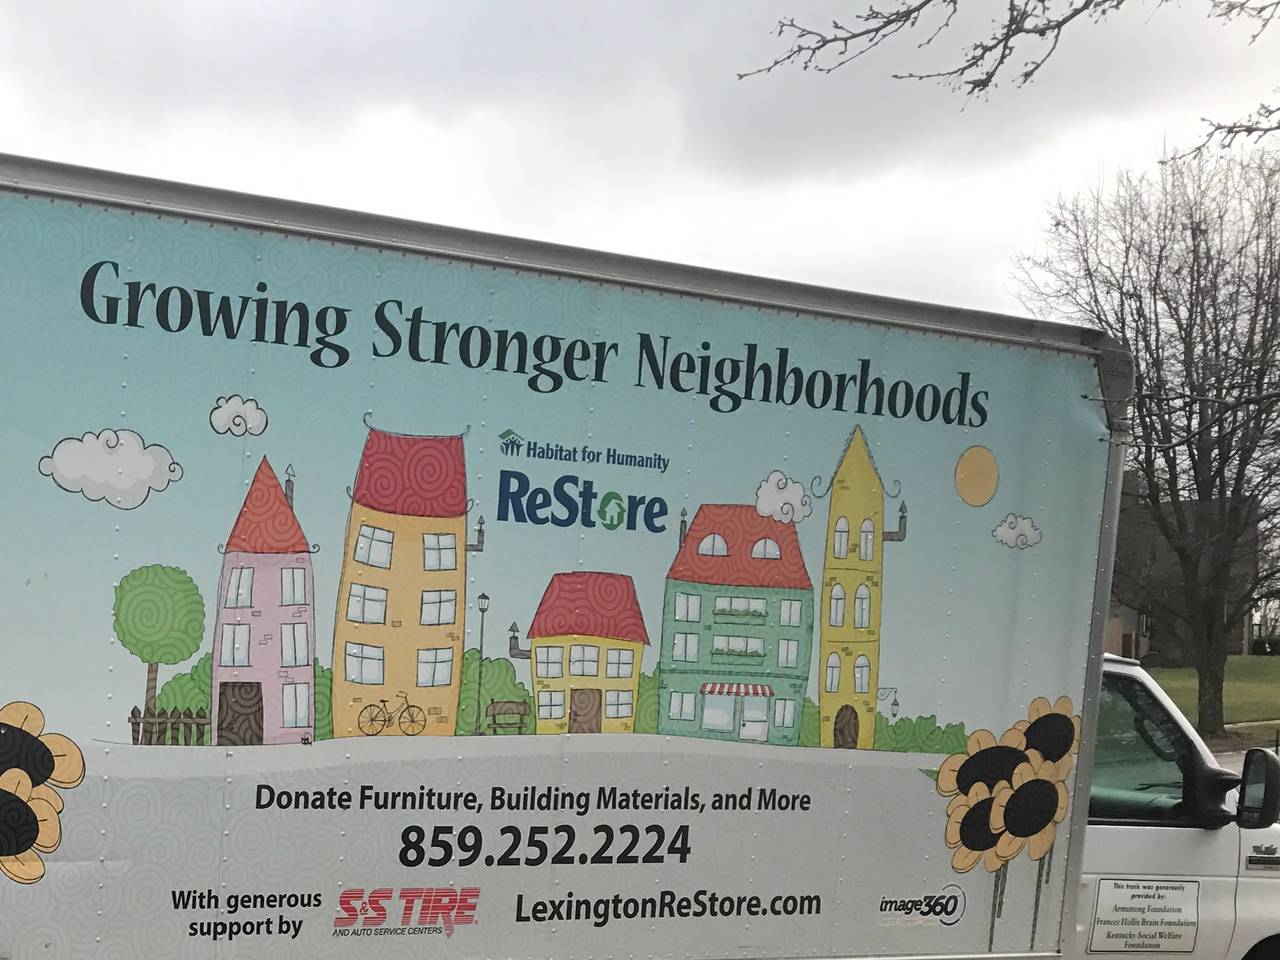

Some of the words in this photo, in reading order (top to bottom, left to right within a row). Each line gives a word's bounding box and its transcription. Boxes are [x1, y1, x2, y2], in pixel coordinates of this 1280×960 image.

[79, 259, 352, 368] Growing
[372, 299, 619, 393] Stronger
[634, 331, 989, 428] Neighborhoods
[526, 441, 578, 463] Habitat
[581, 445, 602, 463] for
[606, 448, 670, 474] Humanity
[497, 469, 668, 533] ReStore
[255, 784, 352, 810] Donate
[359, 785, 483, 814] Furniture,
[490, 786, 590, 816] Building
[596, 786, 706, 814] Materials,
[711, 787, 753, 811] and
[756, 788, 811, 811] More
[399, 824, 691, 867] 859.252.2224
[171, 889, 219, 910] With
[226, 890, 322, 914] generous
[399, 887, 481, 934] TIRE
[515, 890, 821, 927] LexingtonReStore.com
[880, 895, 959, 916] image360
[1112, 904, 1146, 914] Armstrong
[1147, 905, 1182, 913] Foundation
[188, 917, 273, 941] support
[278, 915, 303, 940] by
[332, 928, 349, 937] AND
[351, 928, 372, 936] AUTO
[374, 928, 406, 936] SERVICE
[408, 926, 443, 935] CENTERS
[1096, 918, 1119, 926] Frances
[1160, 919, 1196, 927] Foundation
[1106, 931, 1135, 940] Kentucky
[1158, 931, 1182, 939] Welfare
[1124, 941, 1161, 949] Foundation
